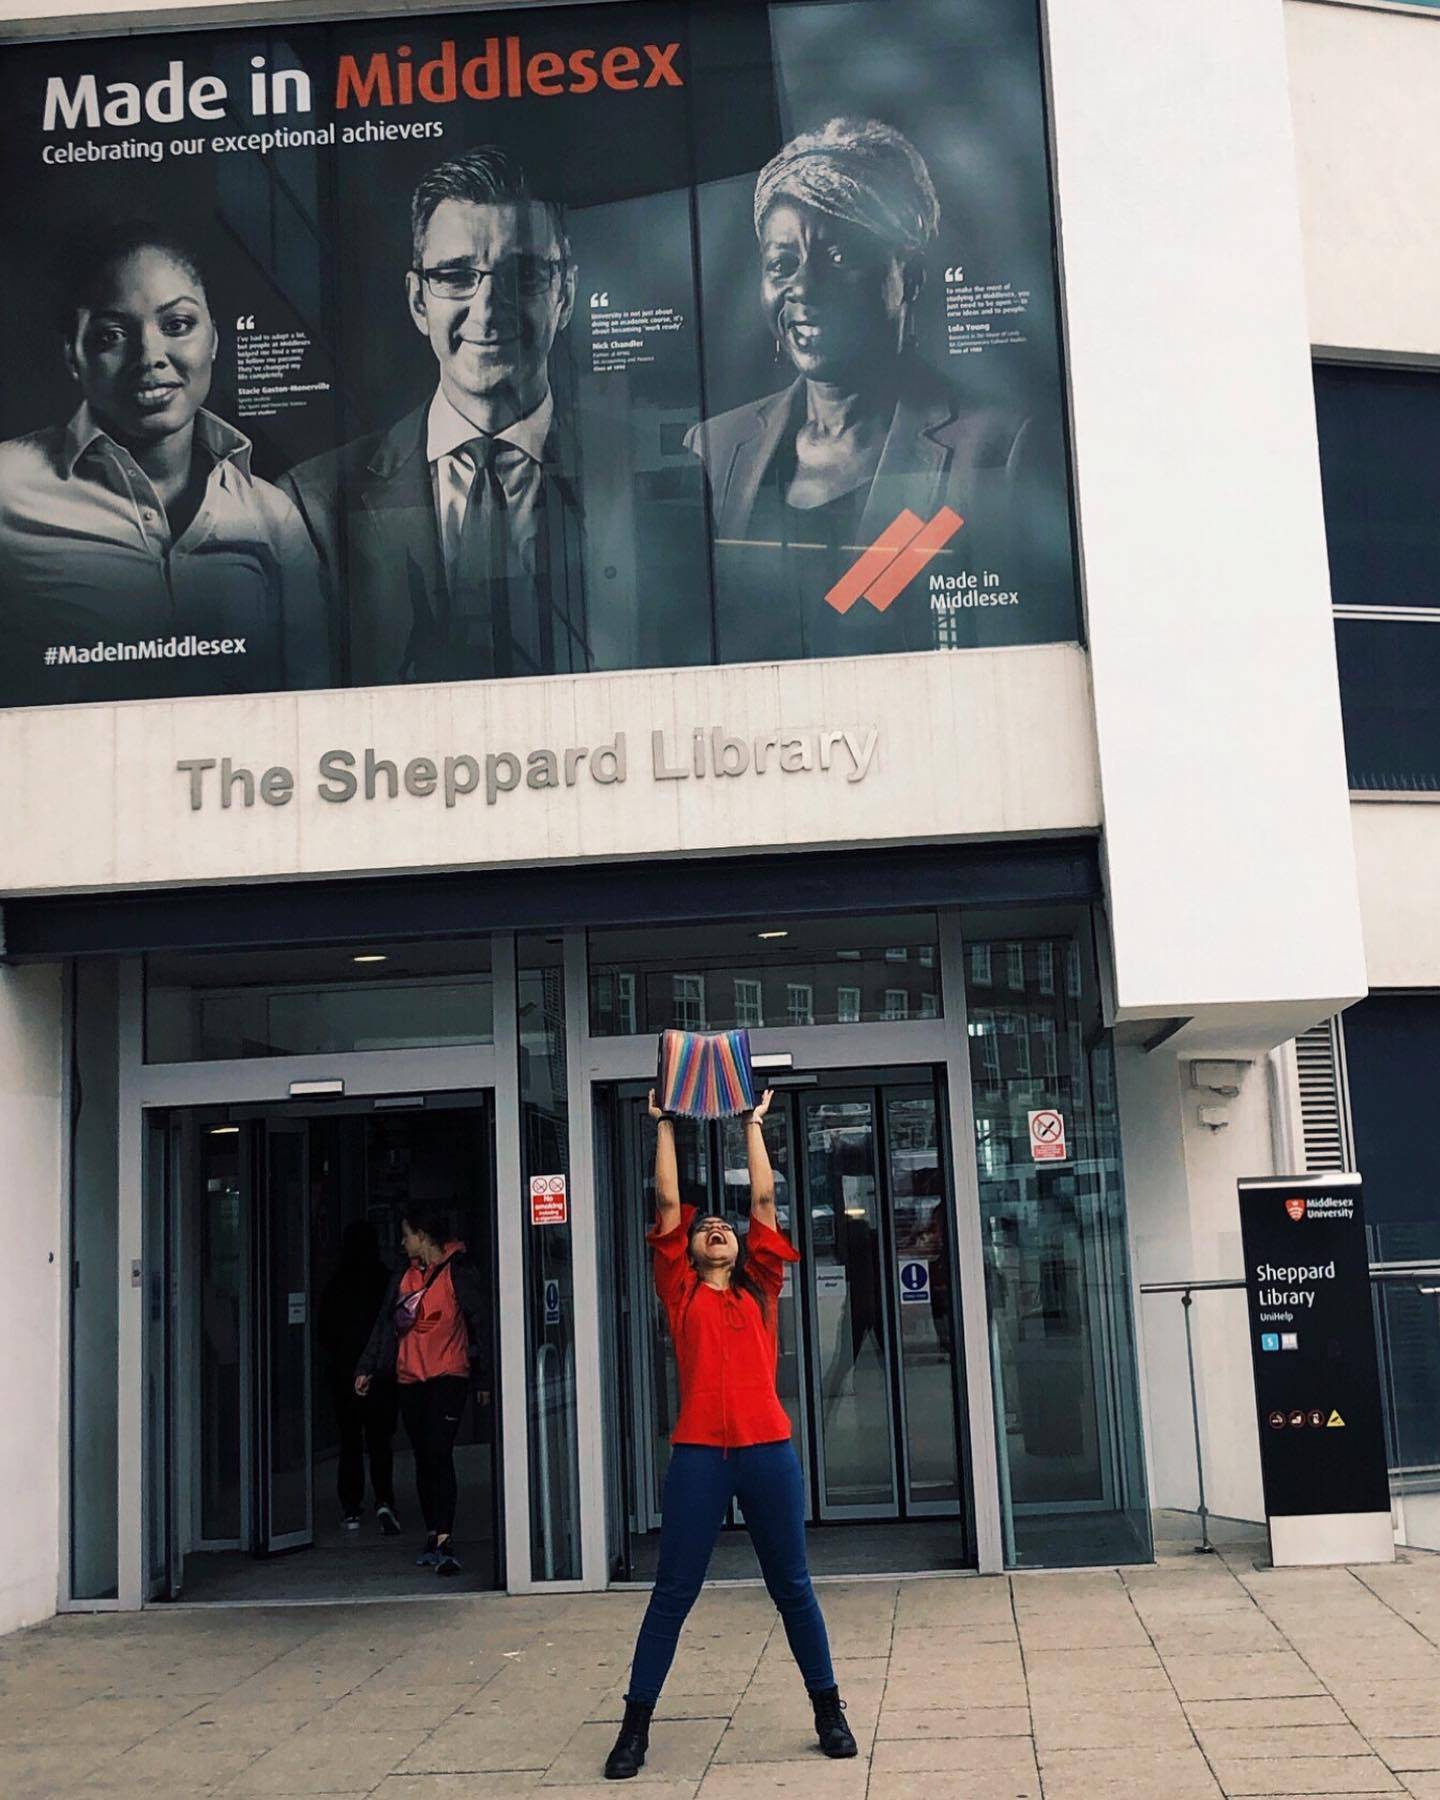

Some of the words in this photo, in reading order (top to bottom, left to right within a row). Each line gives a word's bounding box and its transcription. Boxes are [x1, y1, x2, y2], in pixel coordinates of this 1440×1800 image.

[42, 60, 228, 130] Made
[251, 56, 312, 116] in
[335, 36, 684, 109] Middlesex
[42, 138, 163, 164] Celebrating
[170, 136, 206, 156] our
[211, 122, 335, 154] exceptional
[342, 119, 444, 144] achievers
[592, 342, 609, 350] Nick
[610, 340, 644, 349] Chandler
[930, 571, 978, 590] Made
[983, 570, 999, 587] in
[930, 589, 1019, 610] Middlesex
[44, 635, 246, 665] #MadeInMiddlesex
[176, 756, 295, 811] The
[317, 731, 627, 808] Sheppard
[650, 721, 880, 784] Library
[1306, 1198, 1354, 1208] Middlesex
[1307, 1207, 1354, 1220] University
[1256, 1261, 1336, 1284] Sheppard
[1259, 1288, 1315, 1308] Library
[1260, 1311, 1294, 1323] UniHelp
